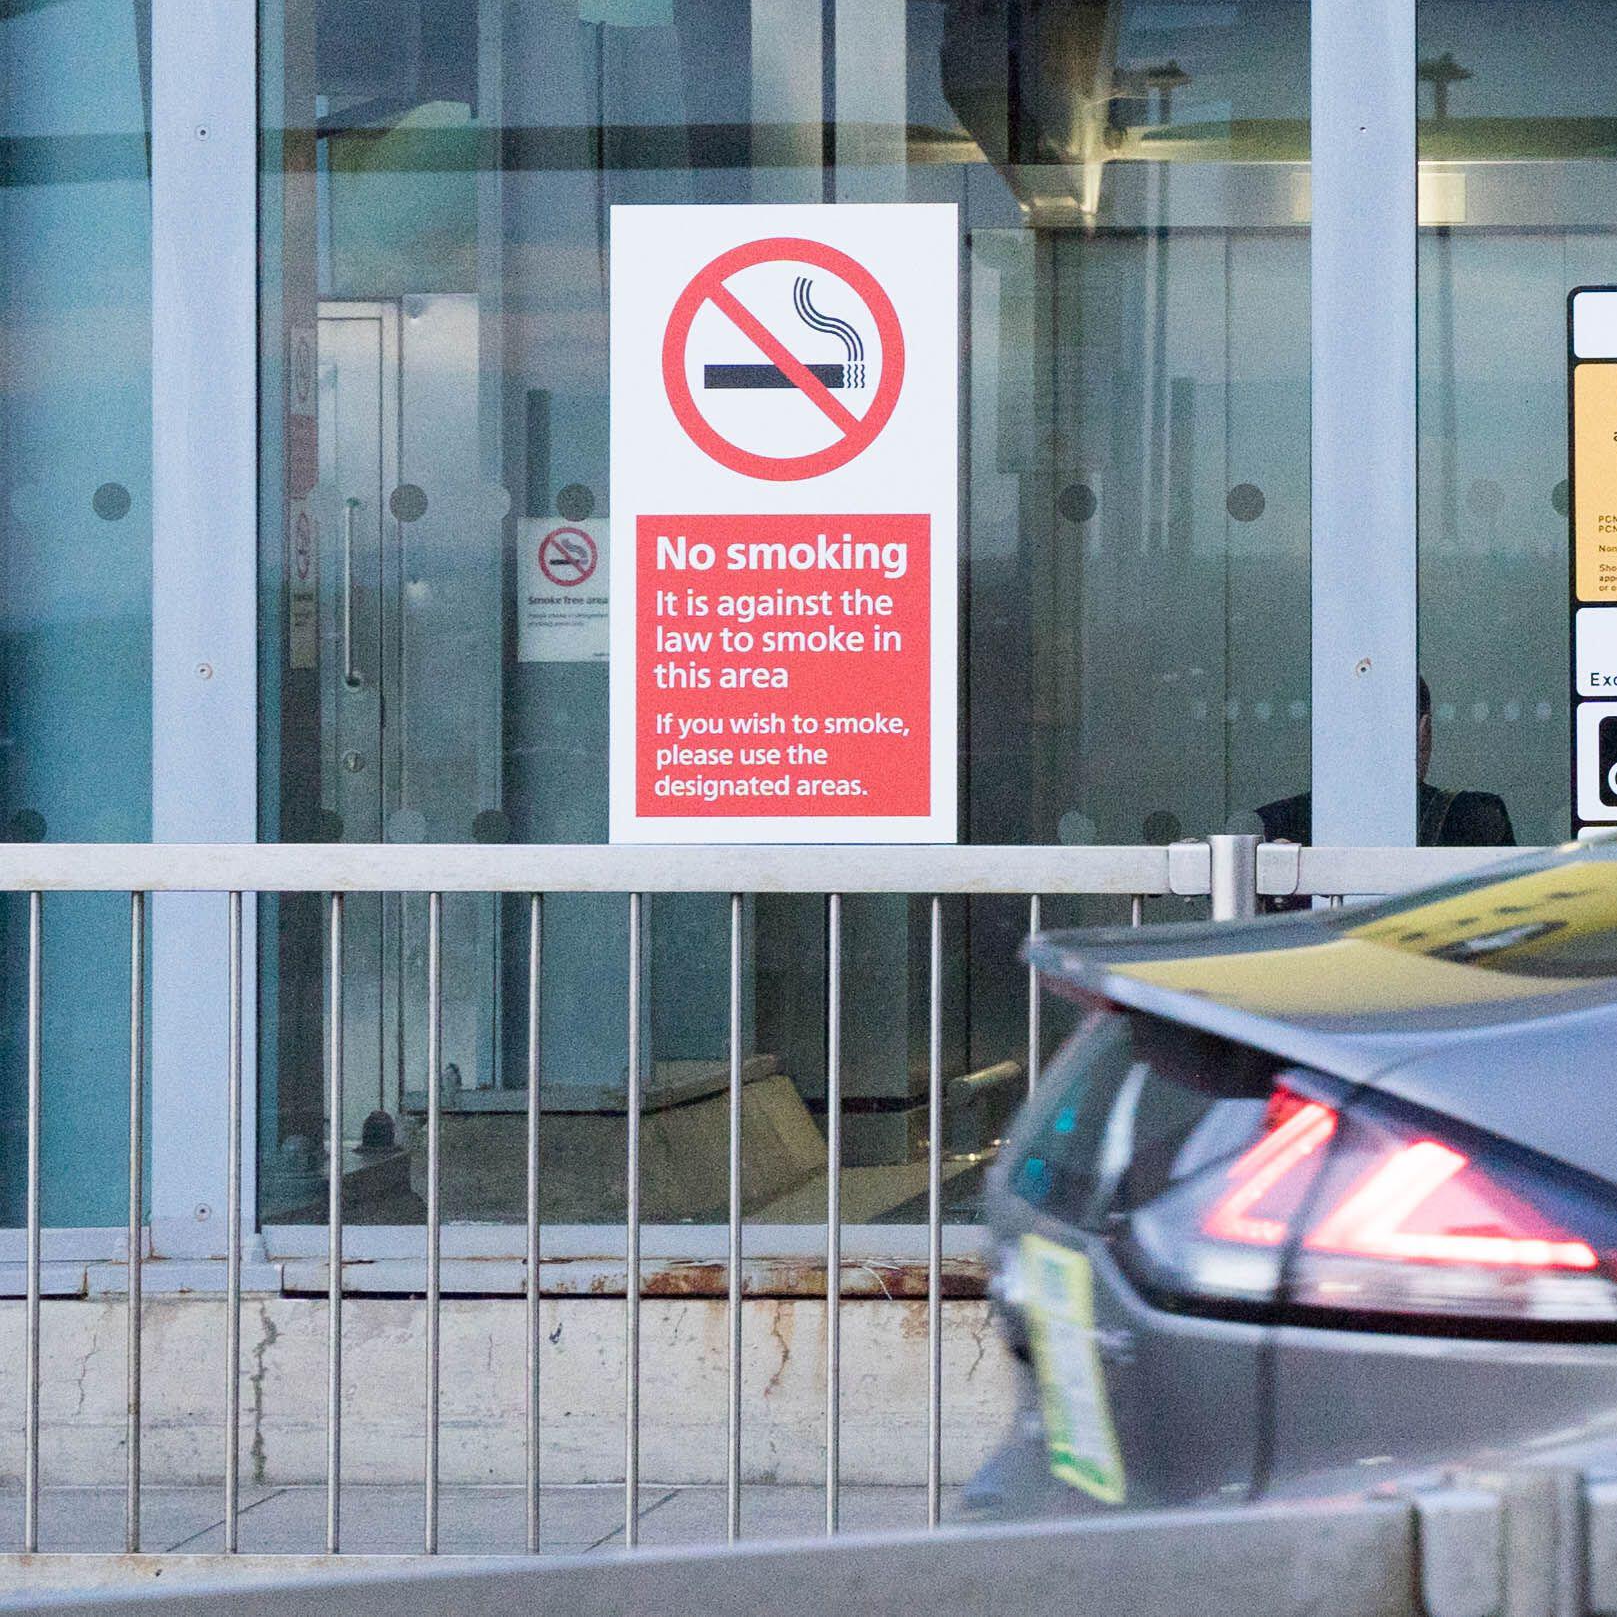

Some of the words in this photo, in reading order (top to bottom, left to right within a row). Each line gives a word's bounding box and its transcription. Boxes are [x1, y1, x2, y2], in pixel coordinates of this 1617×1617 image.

[657, 536, 715, 570] No
[727, 533, 906, 578] smoking
[657, 590, 677, 615] It
[687, 589, 708, 615] is
[717, 588, 832, 622] against
[840, 588, 892, 615] the
[656, 625, 712, 652] law
[719, 628, 753, 652] to
[762, 625, 864, 651] smoke
[874, 624, 901, 651] in
[653, 661, 710, 688] this
[719, 667, 788, 688] area
[656, 712, 673, 733] If
[678, 718, 722, 739] you
[729, 712, 785, 733] wish
[791, 714, 818, 733] to
[824, 712, 909, 736] smoke,
[656, 744, 733, 770] please
[740, 748, 780, 765] use
[786, 743, 828, 764] the
[654, 774, 789, 801] designated
[796, 779, 867, 795] areas.
